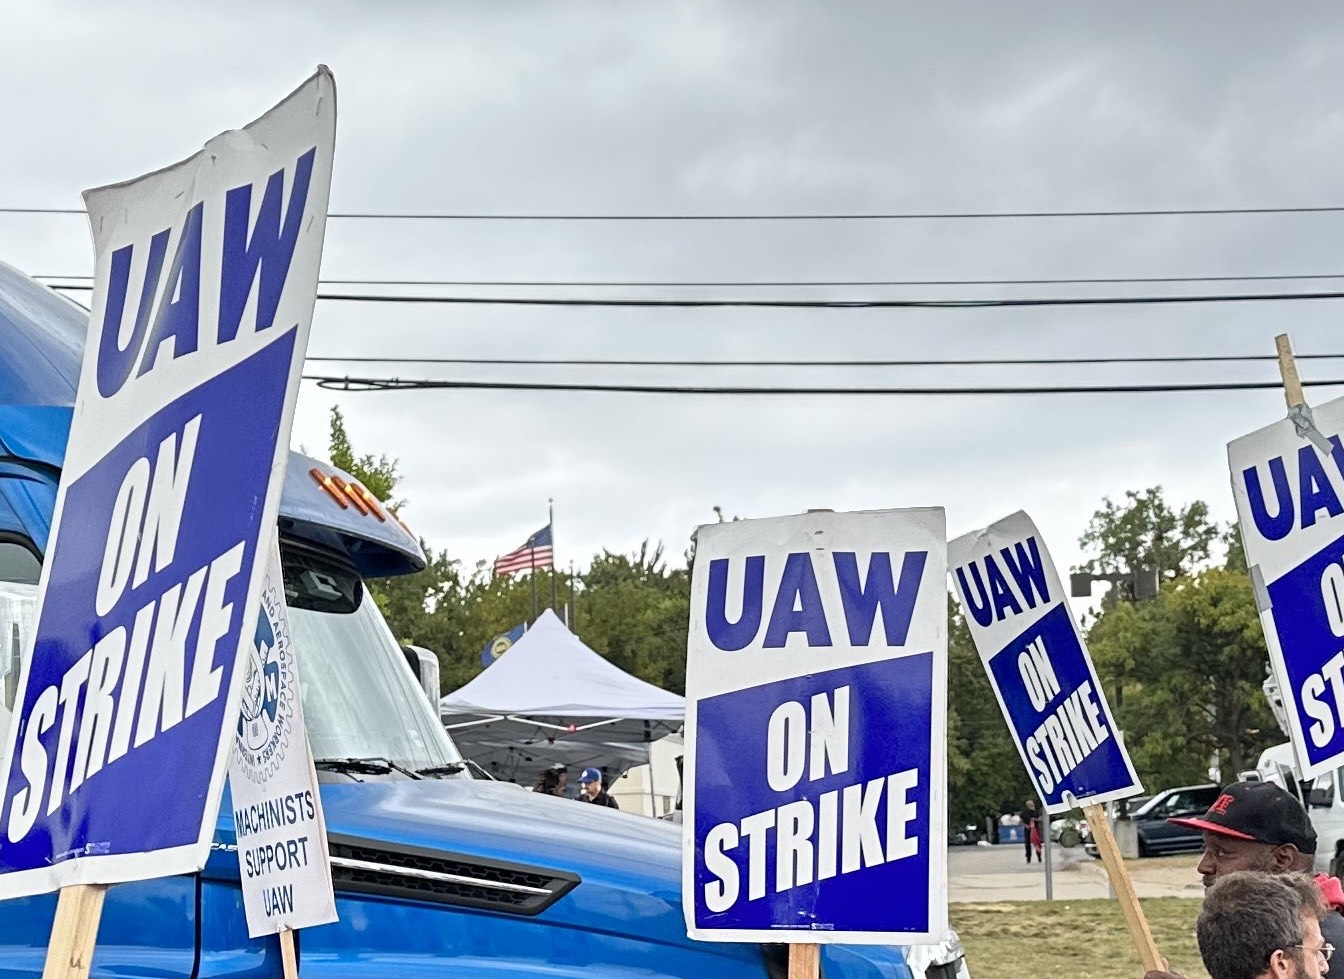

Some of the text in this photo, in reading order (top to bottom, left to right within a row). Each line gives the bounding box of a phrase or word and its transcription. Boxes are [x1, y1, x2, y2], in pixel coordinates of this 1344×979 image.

[96, 145, 318, 400] UAW
[95, 412, 203, 619] ON
[704, 550, 929, 653] UAW
[955, 536, 1052, 629] UAW
[7, 539, 247, 845] STRIKE
[271, 622, 288, 712] AEROSPACE
[1016, 634, 1056, 714] ON
[766, 684, 851, 793] ON
[1025, 679, 1110, 796] STRIKE
[234, 789, 316, 839] MACHINISTS
[244, 836, 309, 879] SUPPORT
[703, 767, 920, 914] STRIKE
[262, 883, 294, 918] UAW
